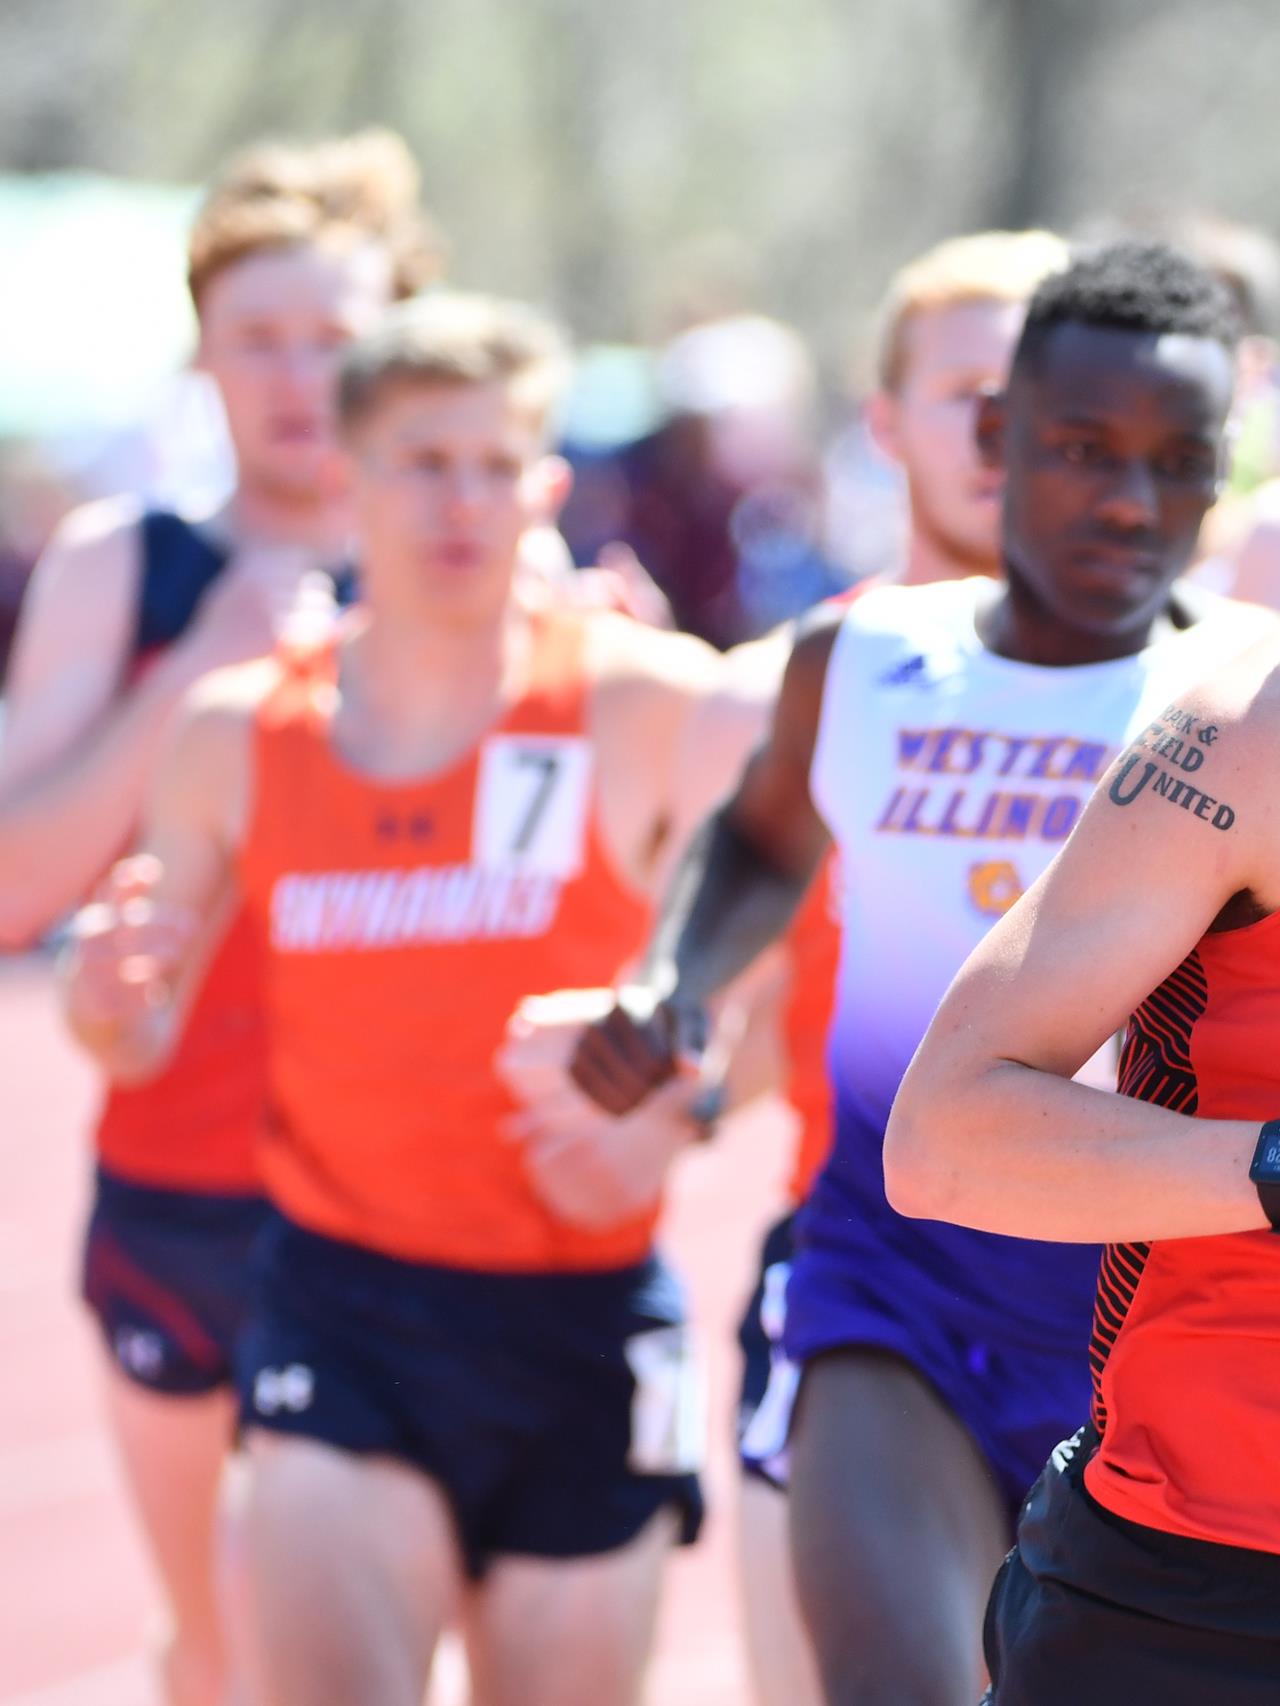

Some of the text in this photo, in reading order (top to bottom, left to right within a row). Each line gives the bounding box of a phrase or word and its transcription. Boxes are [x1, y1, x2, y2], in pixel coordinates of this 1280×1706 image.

[1198, 724, 1218, 747] &
[513, 754, 560, 854] 7
[1108, 753, 1235, 831] UNITED
